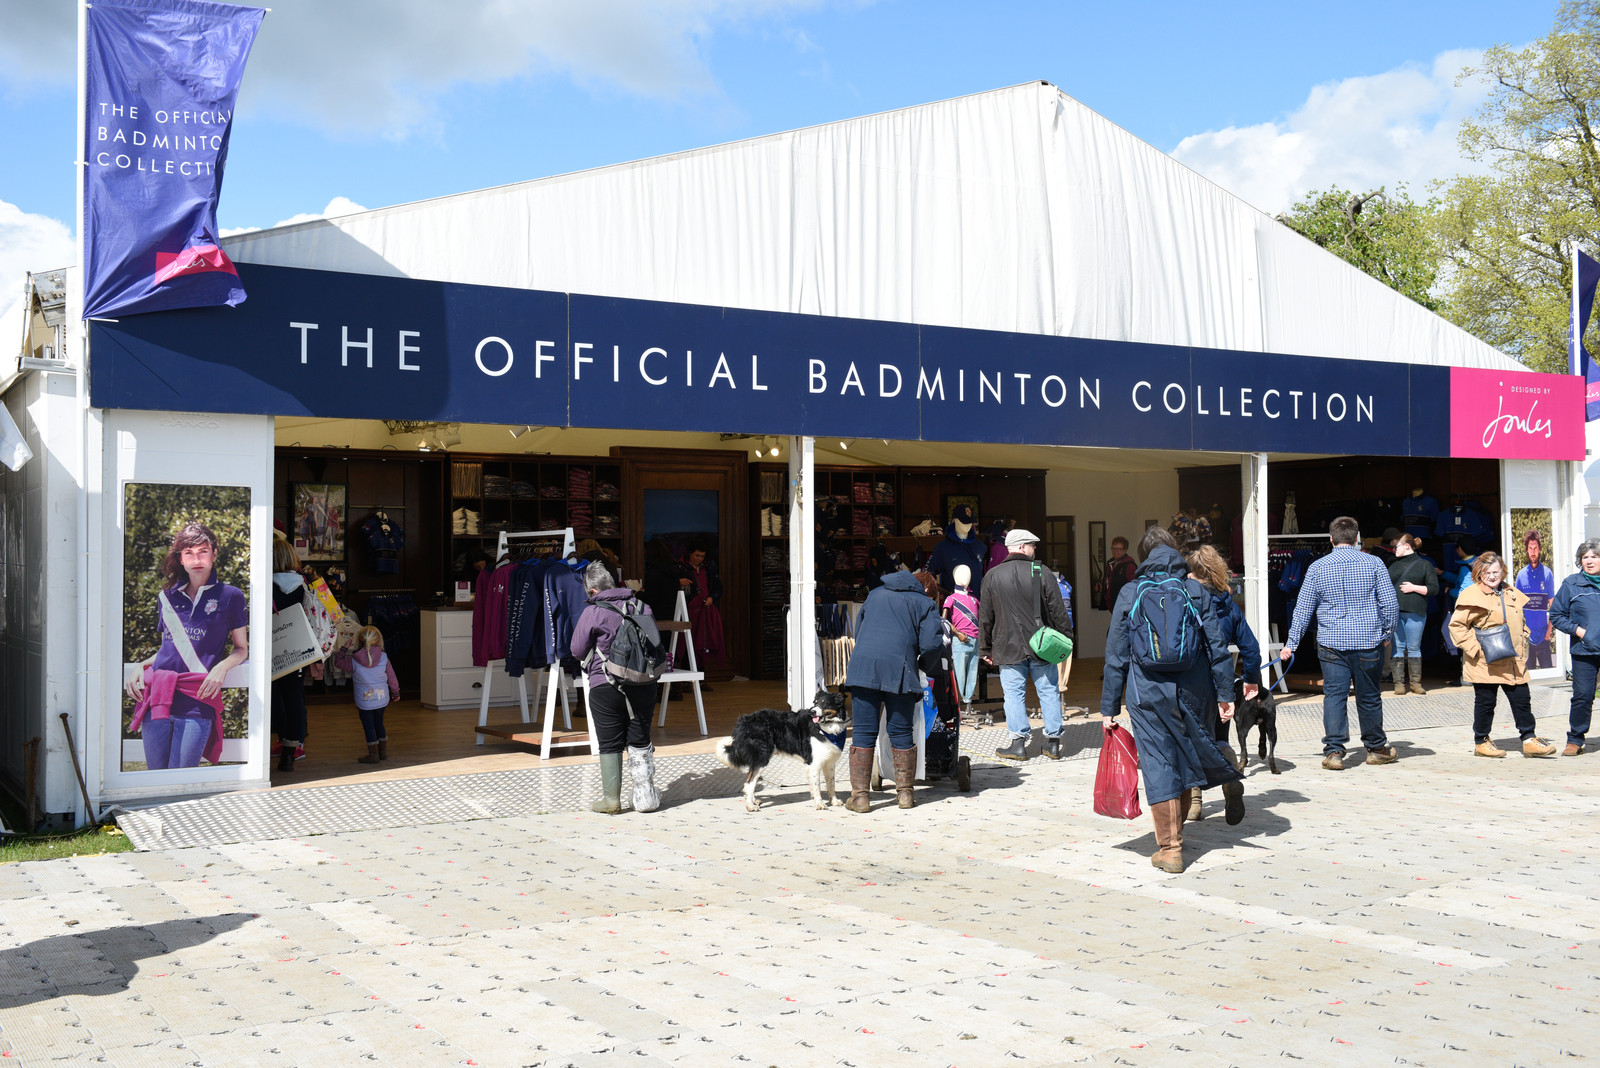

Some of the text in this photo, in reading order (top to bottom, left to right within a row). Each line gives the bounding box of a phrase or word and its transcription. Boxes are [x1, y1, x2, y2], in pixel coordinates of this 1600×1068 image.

[99, 102, 138, 120] THE
[289, 321, 1376, 423] THE OFFICIAL BADMINTON COLLECTION
[1511, 385, 1541, 394] DESIGNED
